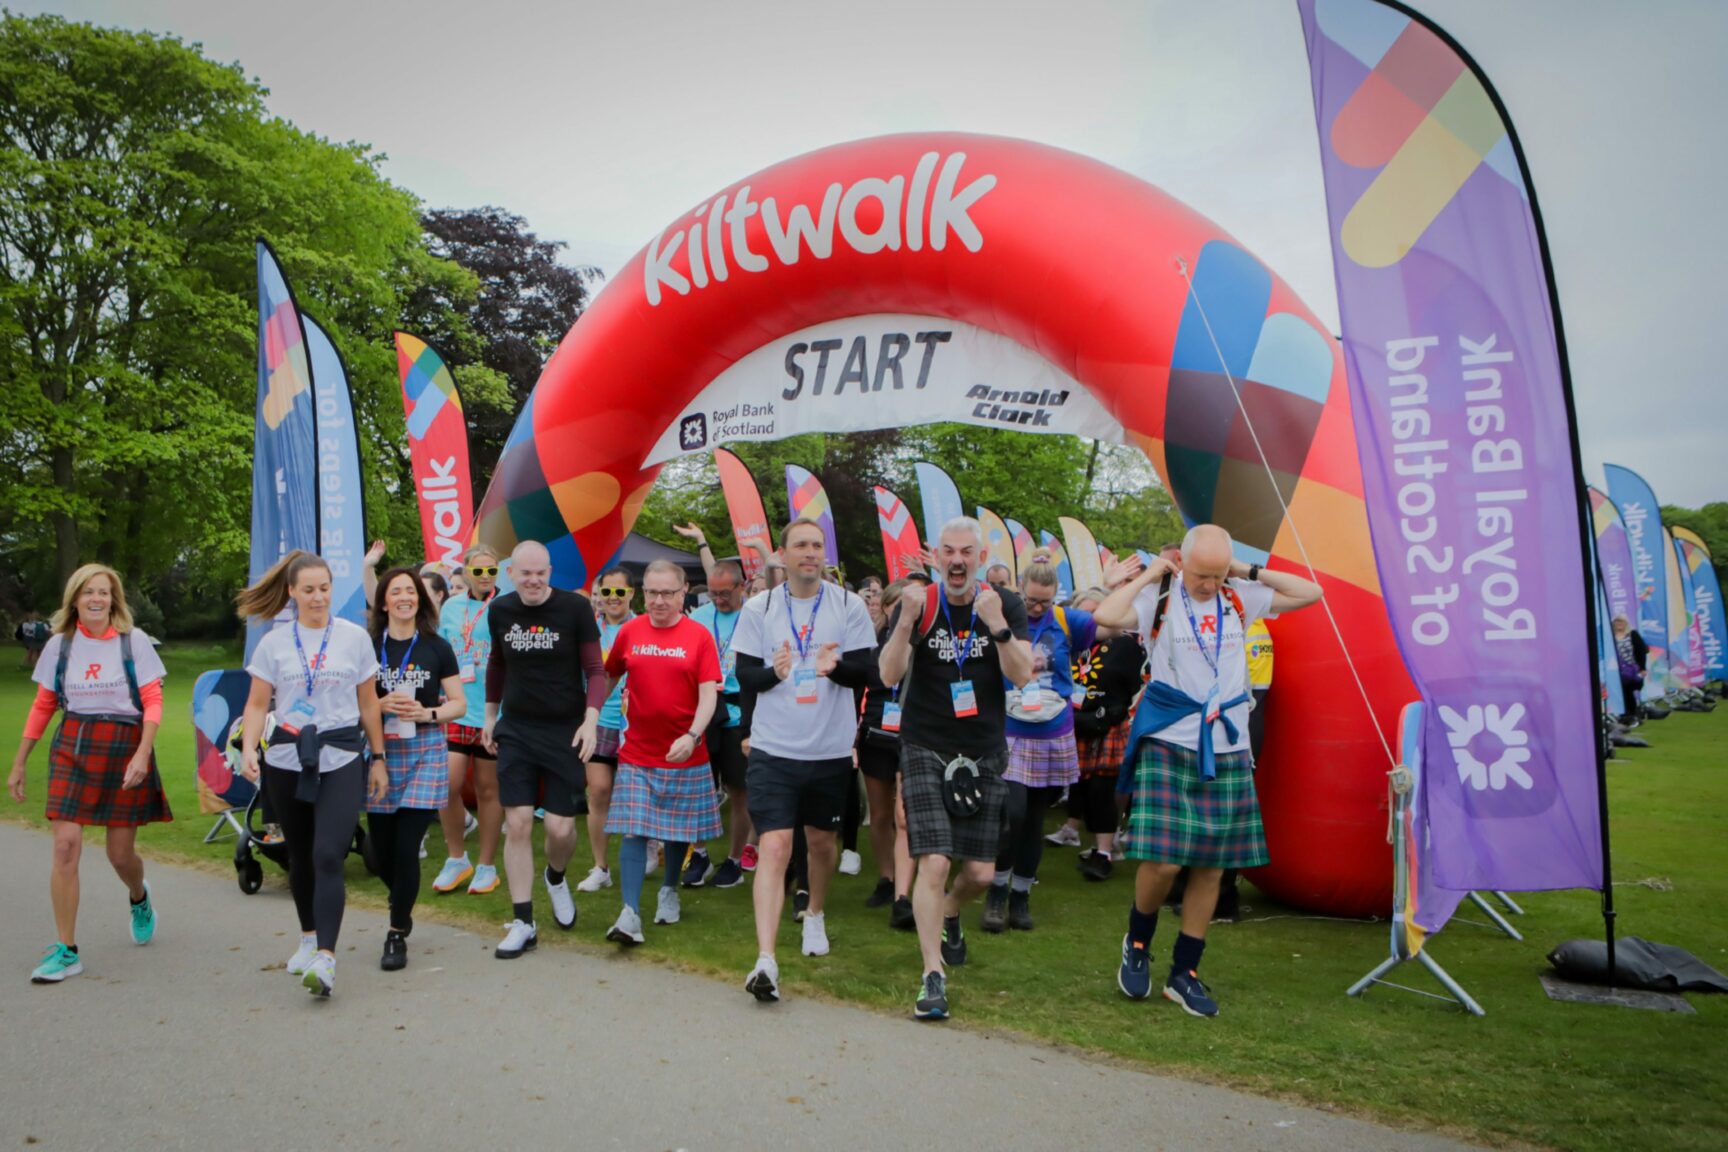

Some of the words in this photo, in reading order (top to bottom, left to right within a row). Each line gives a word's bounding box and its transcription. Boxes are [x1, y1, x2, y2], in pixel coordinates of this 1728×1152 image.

[644, 151, 997, 307] kiltwalk
[782, 330, 952, 401] START
[965, 384, 1070, 406] Arnold
[712, 404, 739, 425] Royal
[742, 402, 774, 417] Bank
[972, 402, 1052, 426] Clark
[722, 420, 775, 438] Scotland
[504, 628, 559, 643] children's
[511, 639, 554, 652] appeal
[640, 644, 687, 659] kiltwalk
[938, 643, 984, 662] apal
[376, 666, 431, 680] hldren's
